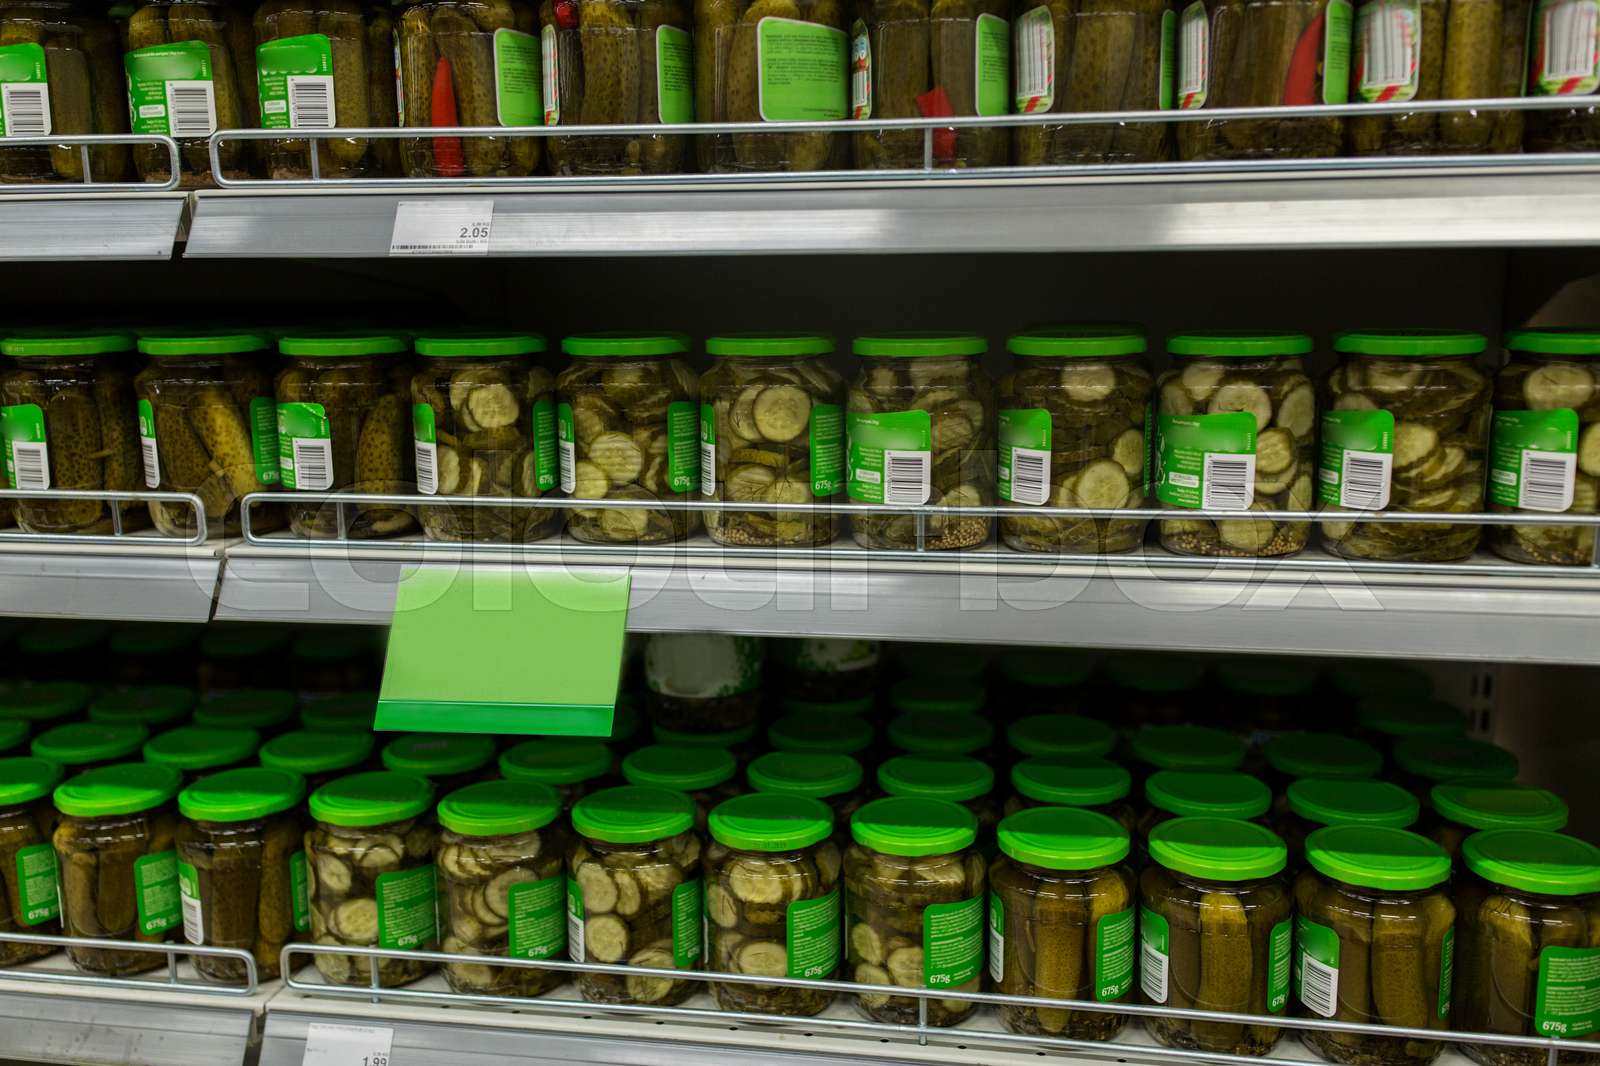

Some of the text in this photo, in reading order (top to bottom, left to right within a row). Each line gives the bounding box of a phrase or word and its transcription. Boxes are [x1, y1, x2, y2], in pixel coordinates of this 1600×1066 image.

[460, 227, 489, 238] 2.05
[930, 974, 951, 984] 675g
[1102, 985, 1119, 997] 675g
[1542, 1020, 1568, 1033] 675g
